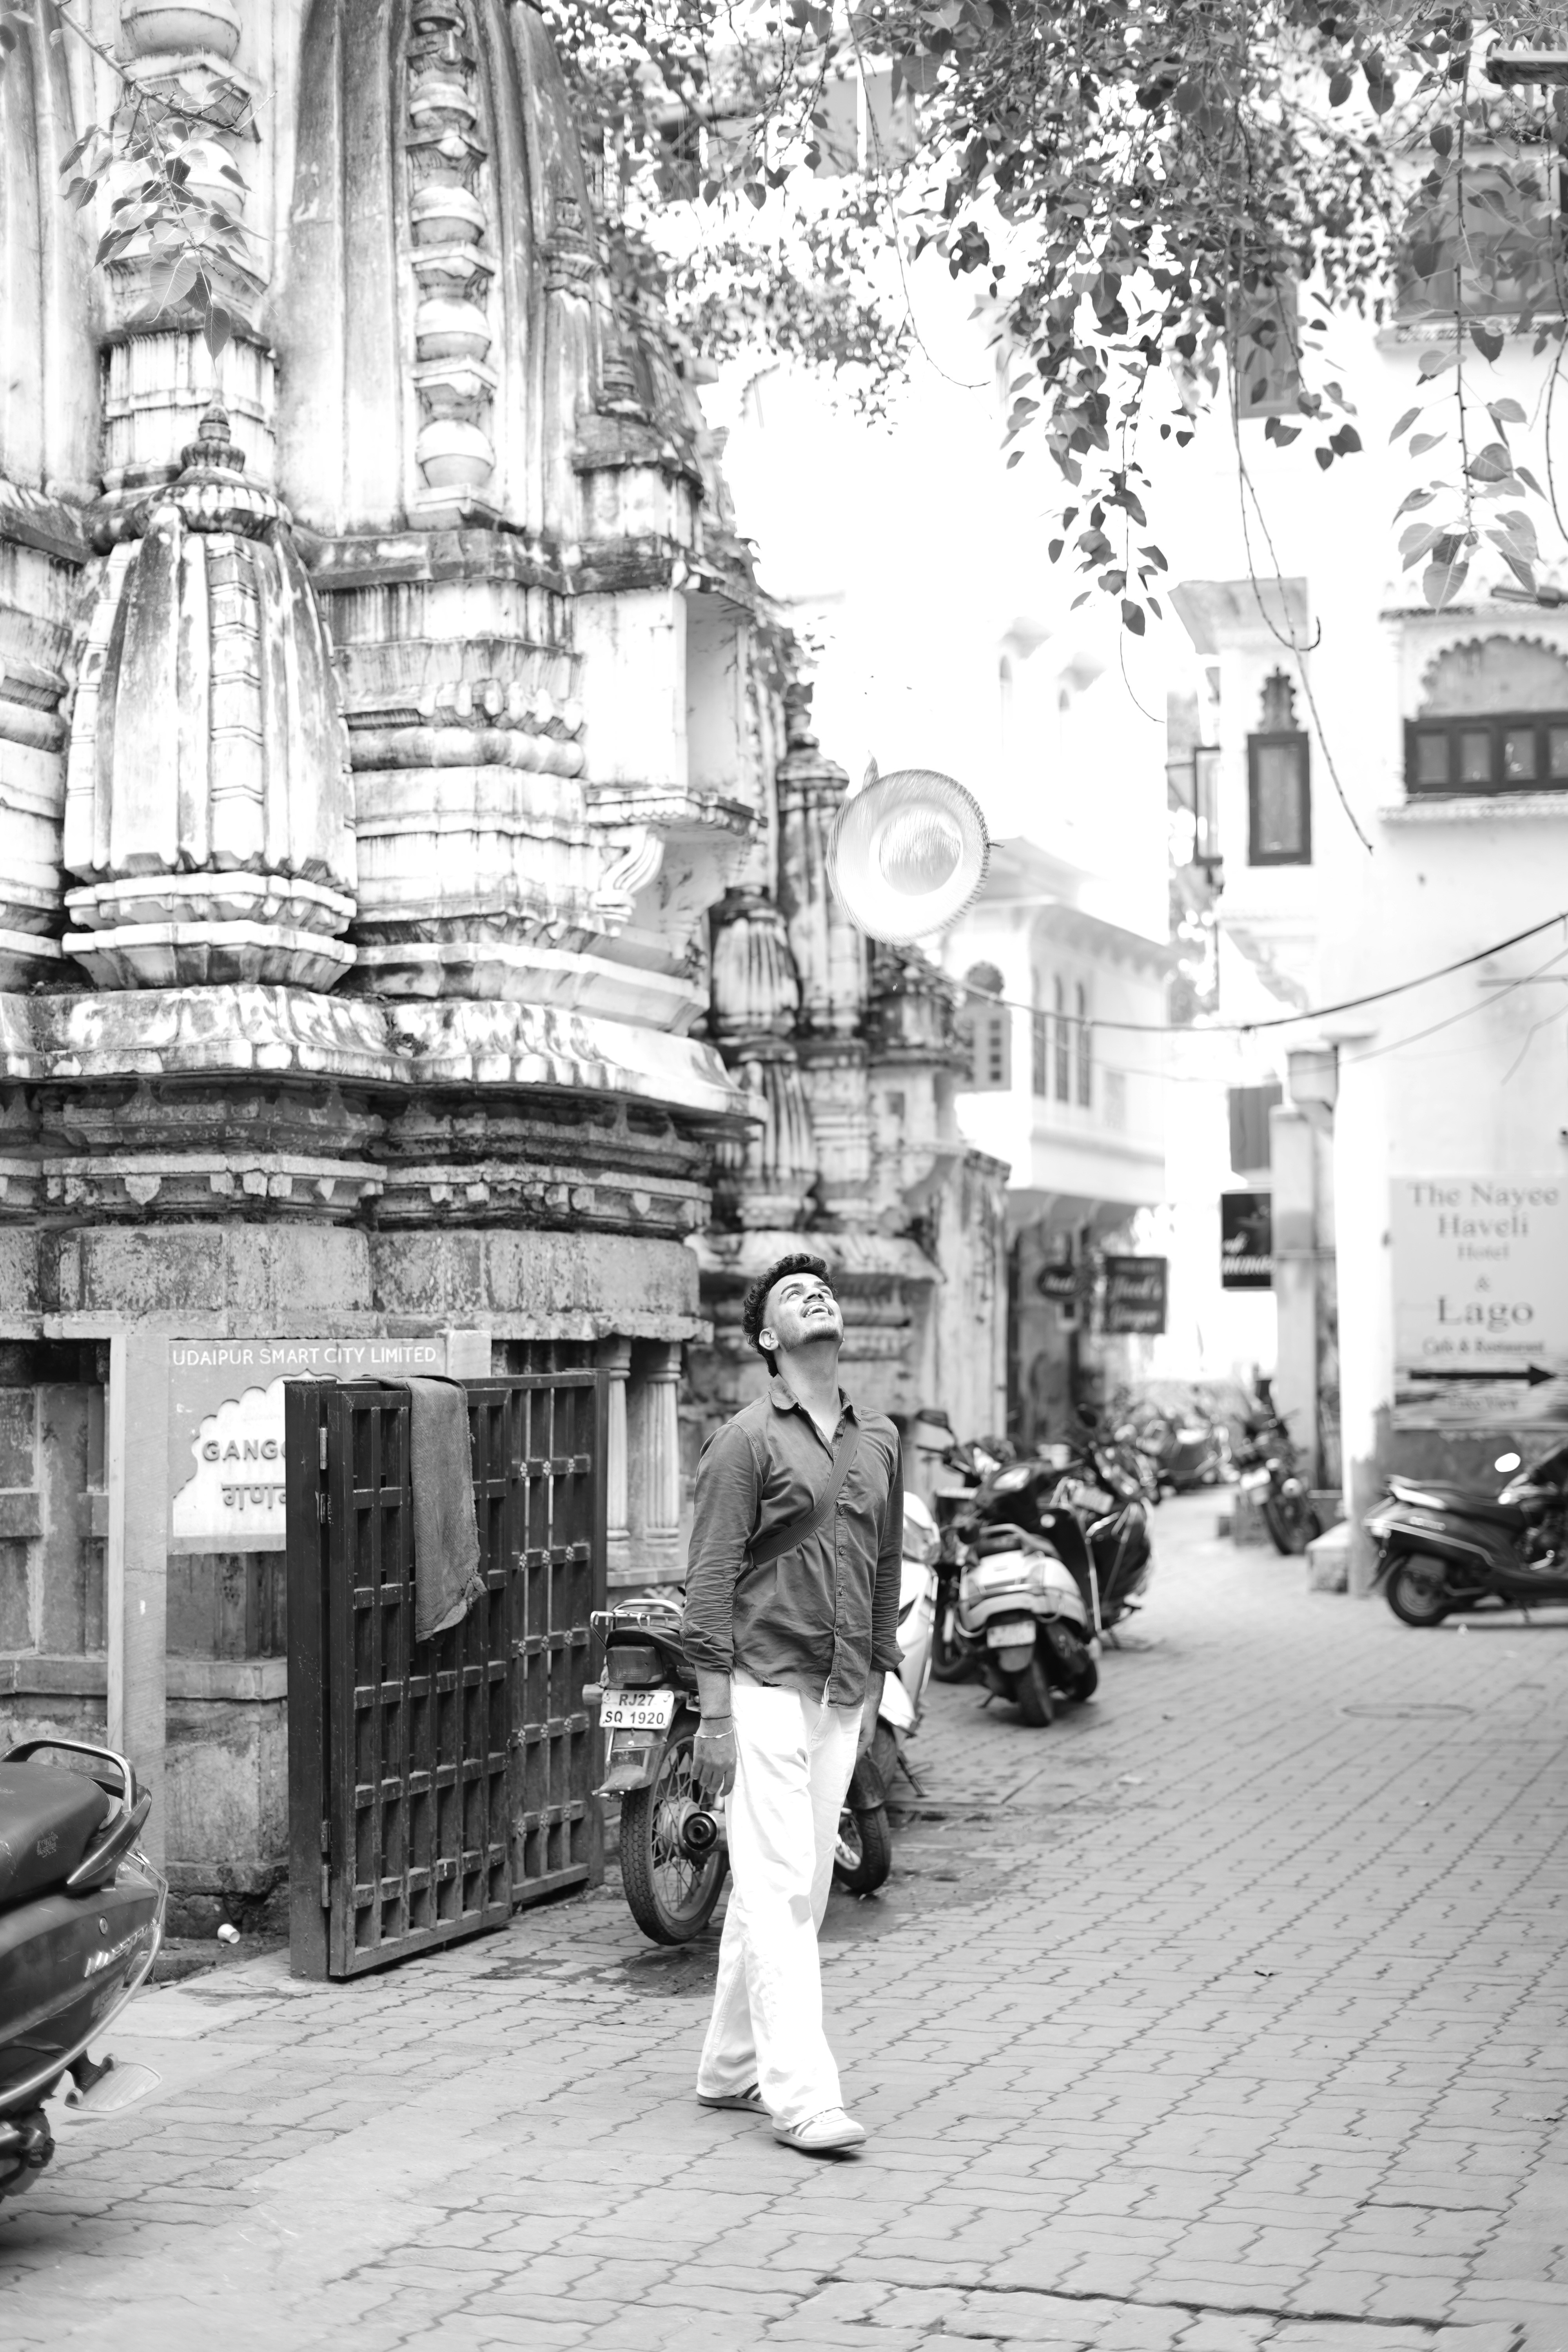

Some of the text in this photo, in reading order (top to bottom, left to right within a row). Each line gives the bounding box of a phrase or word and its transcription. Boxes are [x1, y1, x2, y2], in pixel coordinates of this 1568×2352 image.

[1407, 1181, 1461, 1207] The
[1438, 1212, 1528, 1238] Haveli
[1437, 1295, 1534, 1332] Lago
[173, 1347, 436, 1365] UDAIPUR SMART CITY LIMITED
[202, 1438, 285, 1461] GANG
[619, 1694, 655, 1706] RJ27
[605, 1711, 664, 1724] SQ 1920
